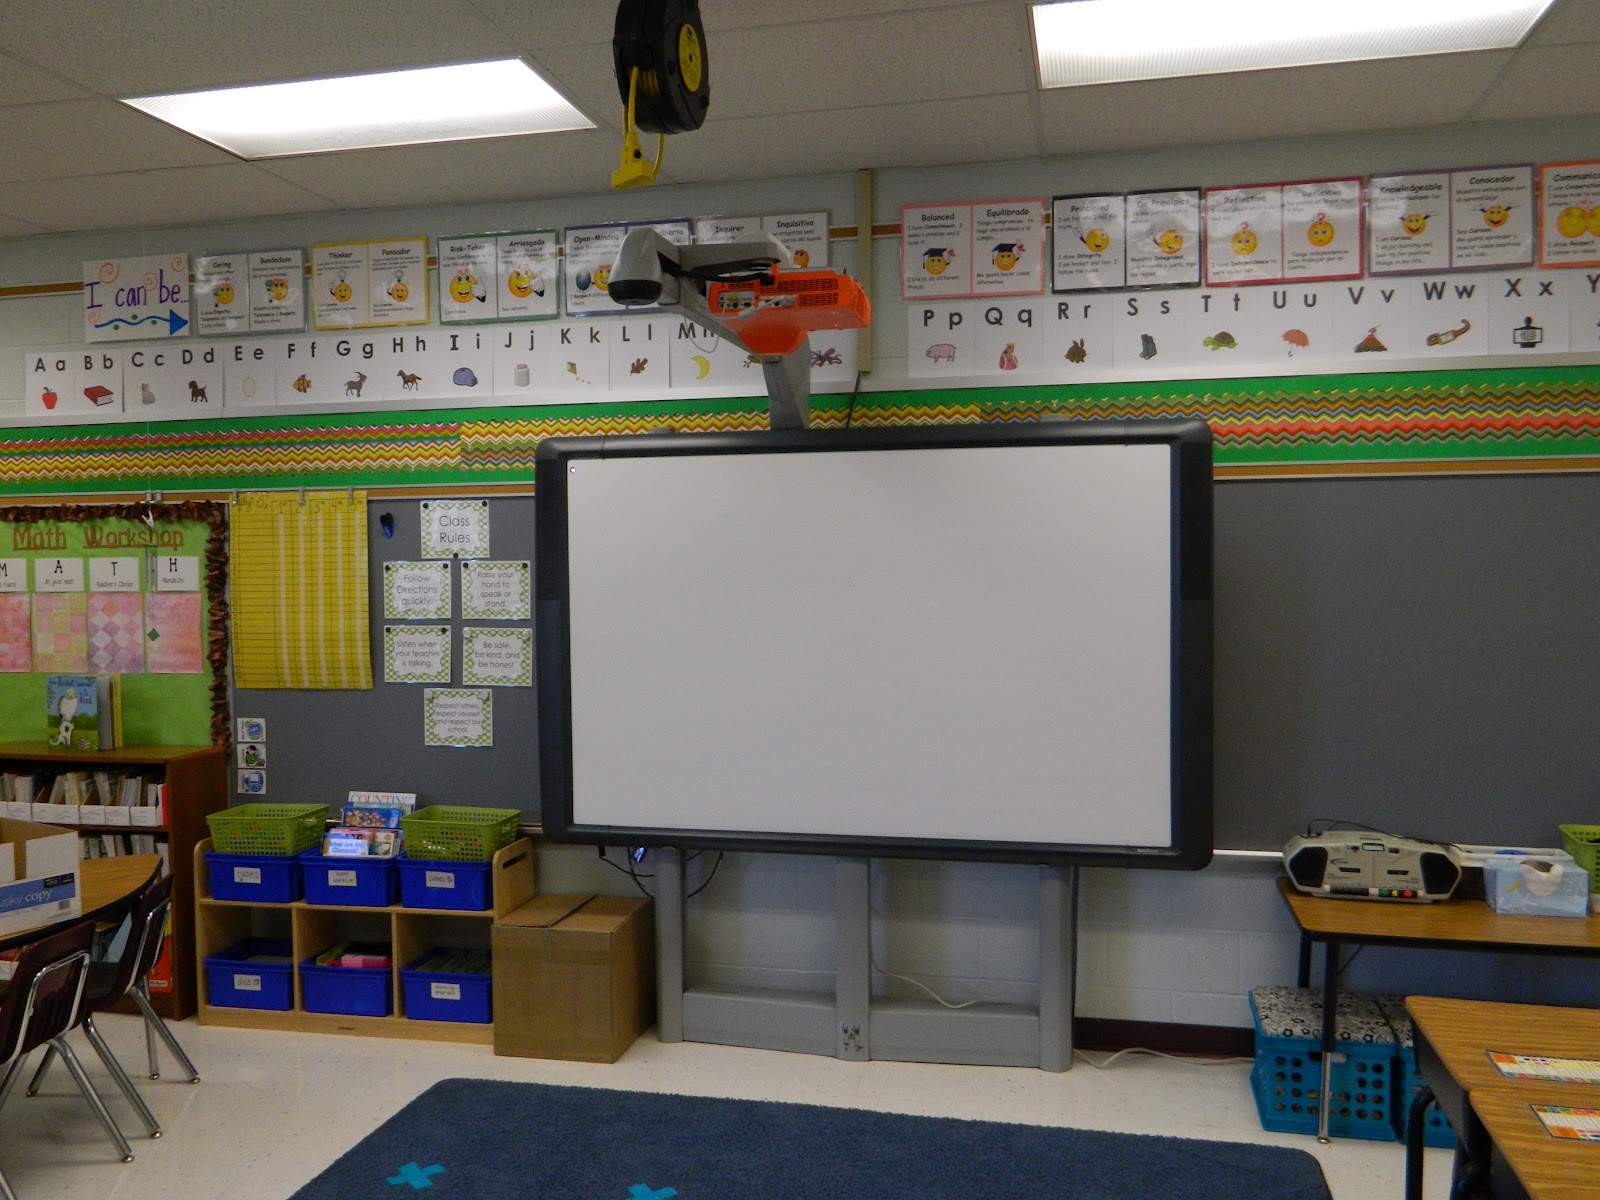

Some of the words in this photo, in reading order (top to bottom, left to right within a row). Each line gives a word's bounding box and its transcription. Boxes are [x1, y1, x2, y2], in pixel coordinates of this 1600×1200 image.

[1469, 175, 1516, 185] Conocedor
[1379, 183, 1443, 194] Knowledgeable
[921, 213, 955, 222] Balanced
[986, 207, 1030, 218] Equilibrado
[715, 225, 745, 234] Inquirer
[776, 220, 814, 229] Inquisitivo
[508, 239, 545, 248] Arriesgado
[573, 234, 619, 244] Open-Minded
[382, 248, 412, 256] Pensador
[213, 261, 232, 269] Caring
[1422, 281, 1447, 301] W
[1453, 284, 1476, 300] w
[1503, 277, 1523, 298] X
[1537, 280, 1554, 297] x
[85, 282, 103, 309] I
[115, 285, 147, 307] can
[1272, 289, 1287, 310] U
[1303, 293, 1317, 308] u
[1347, 285, 1365, 305] V
[1379, 288, 1396, 304] v
[1126, 297, 1139, 317] S
[1159, 300, 1171, 315] s
[1200, 294, 1213, 313] T
[1232, 292, 1241, 312] t
[984, 306, 1004, 327] Q
[1017, 308, 1033, 328] q
[1057, 301, 1070, 321] R
[1083, 304, 1092, 319] r
[923, 309, 935, 328] P
[948, 311, 964, 331] p
[560, 327, 573, 345] K
[589, 326, 601, 344] k
[621, 325, 631, 343] L
[678, 322, 696, 339] M
[392, 336, 404, 354] H
[415, 335, 427, 352] h
[503, 331, 513, 349] J
[528, 329, 535, 352] j
[181, 348, 194, 365] D
[203, 347, 215, 364] d
[234, 345, 243, 362] E
[252, 347, 265, 361] e
[287, 342, 296, 359] F
[310, 341, 317, 358] f
[335, 339, 352, 357] G
[361, 342, 374, 360] g
[34, 357, 47, 373] A
[55, 359, 66, 372] a
[83, 355, 94, 371] B
[102, 353, 114, 370] b
[131, 351, 145, 368] C
[154, 354, 165, 367] c
[439, 515, 471, 528] Class
[12, 527, 67, 549] Math
[83, 526, 185, 550] Workshop
[439, 532, 471, 544] Rules
[54, 559, 64, 574] A
[110, 561, 119, 577] T
[169, 558, 178, 573] H
[403, 573, 431, 583] Follow
[477, 571, 496, 579] Raise
[497, 572, 514, 582] your
[396, 585, 438, 594] Directions
[481, 581, 501, 589] hand
[502, 581, 511, 589] to
[401, 596, 433, 607] quickly.
[480, 591, 503, 600] speak
[484, 600, 508, 608] stand.
[397, 640, 417, 648] Listen
[418, 640, 438, 648] when
[483, 641, 493, 649] Be
[395, 650, 411, 659] your
[412, 649, 441, 658] teacher
[474, 651, 486, 659] be
[504, 651, 520, 660] and
[401, 659, 408, 668] is
[408, 659, 433, 669] talking.
[478, 661, 489, 669] be
[435, 702, 459, 711] Respect
[460, 702, 481, 710] others,
[448, 718, 471, 727] respect
[447, 726, 469, 734] school.
[24, 889, 53, 903] copy
